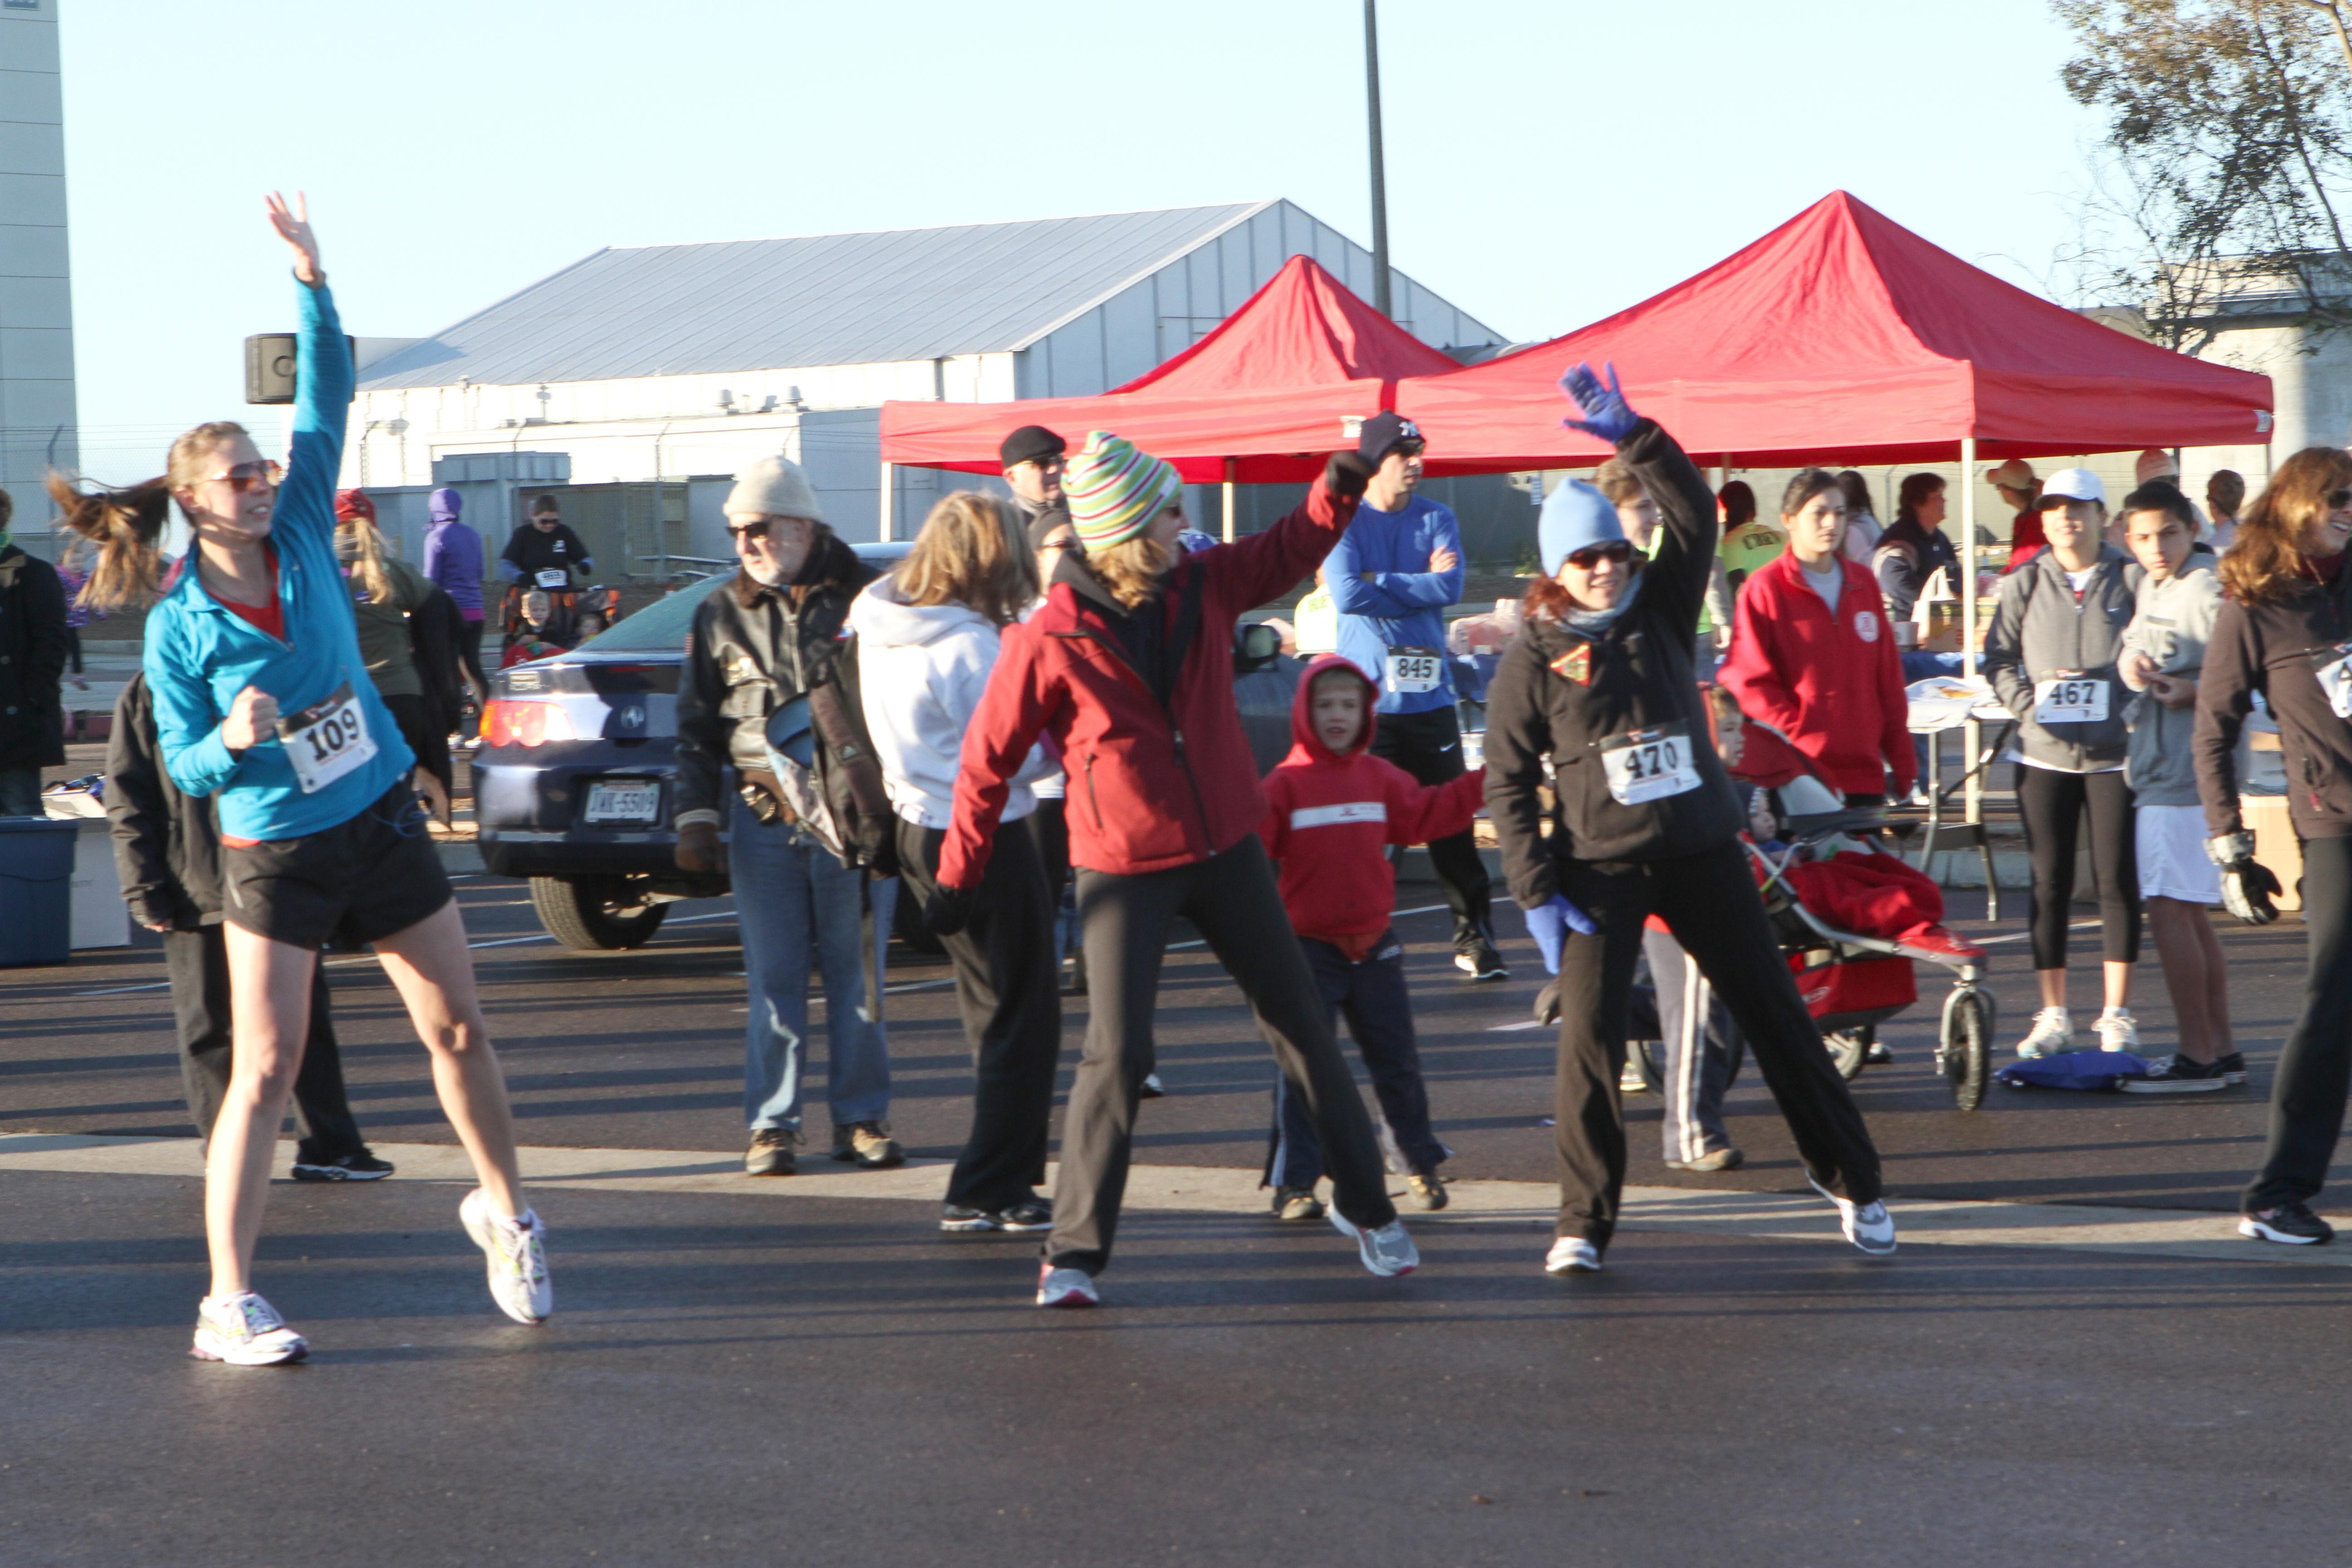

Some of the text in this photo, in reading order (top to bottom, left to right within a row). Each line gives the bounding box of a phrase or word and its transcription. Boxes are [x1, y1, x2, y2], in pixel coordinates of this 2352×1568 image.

[1398, 657, 1433, 679] 845
[2049, 682, 2096, 705] 467
[306, 709, 359, 761] 109
[1626, 741, 1678, 779] 470
